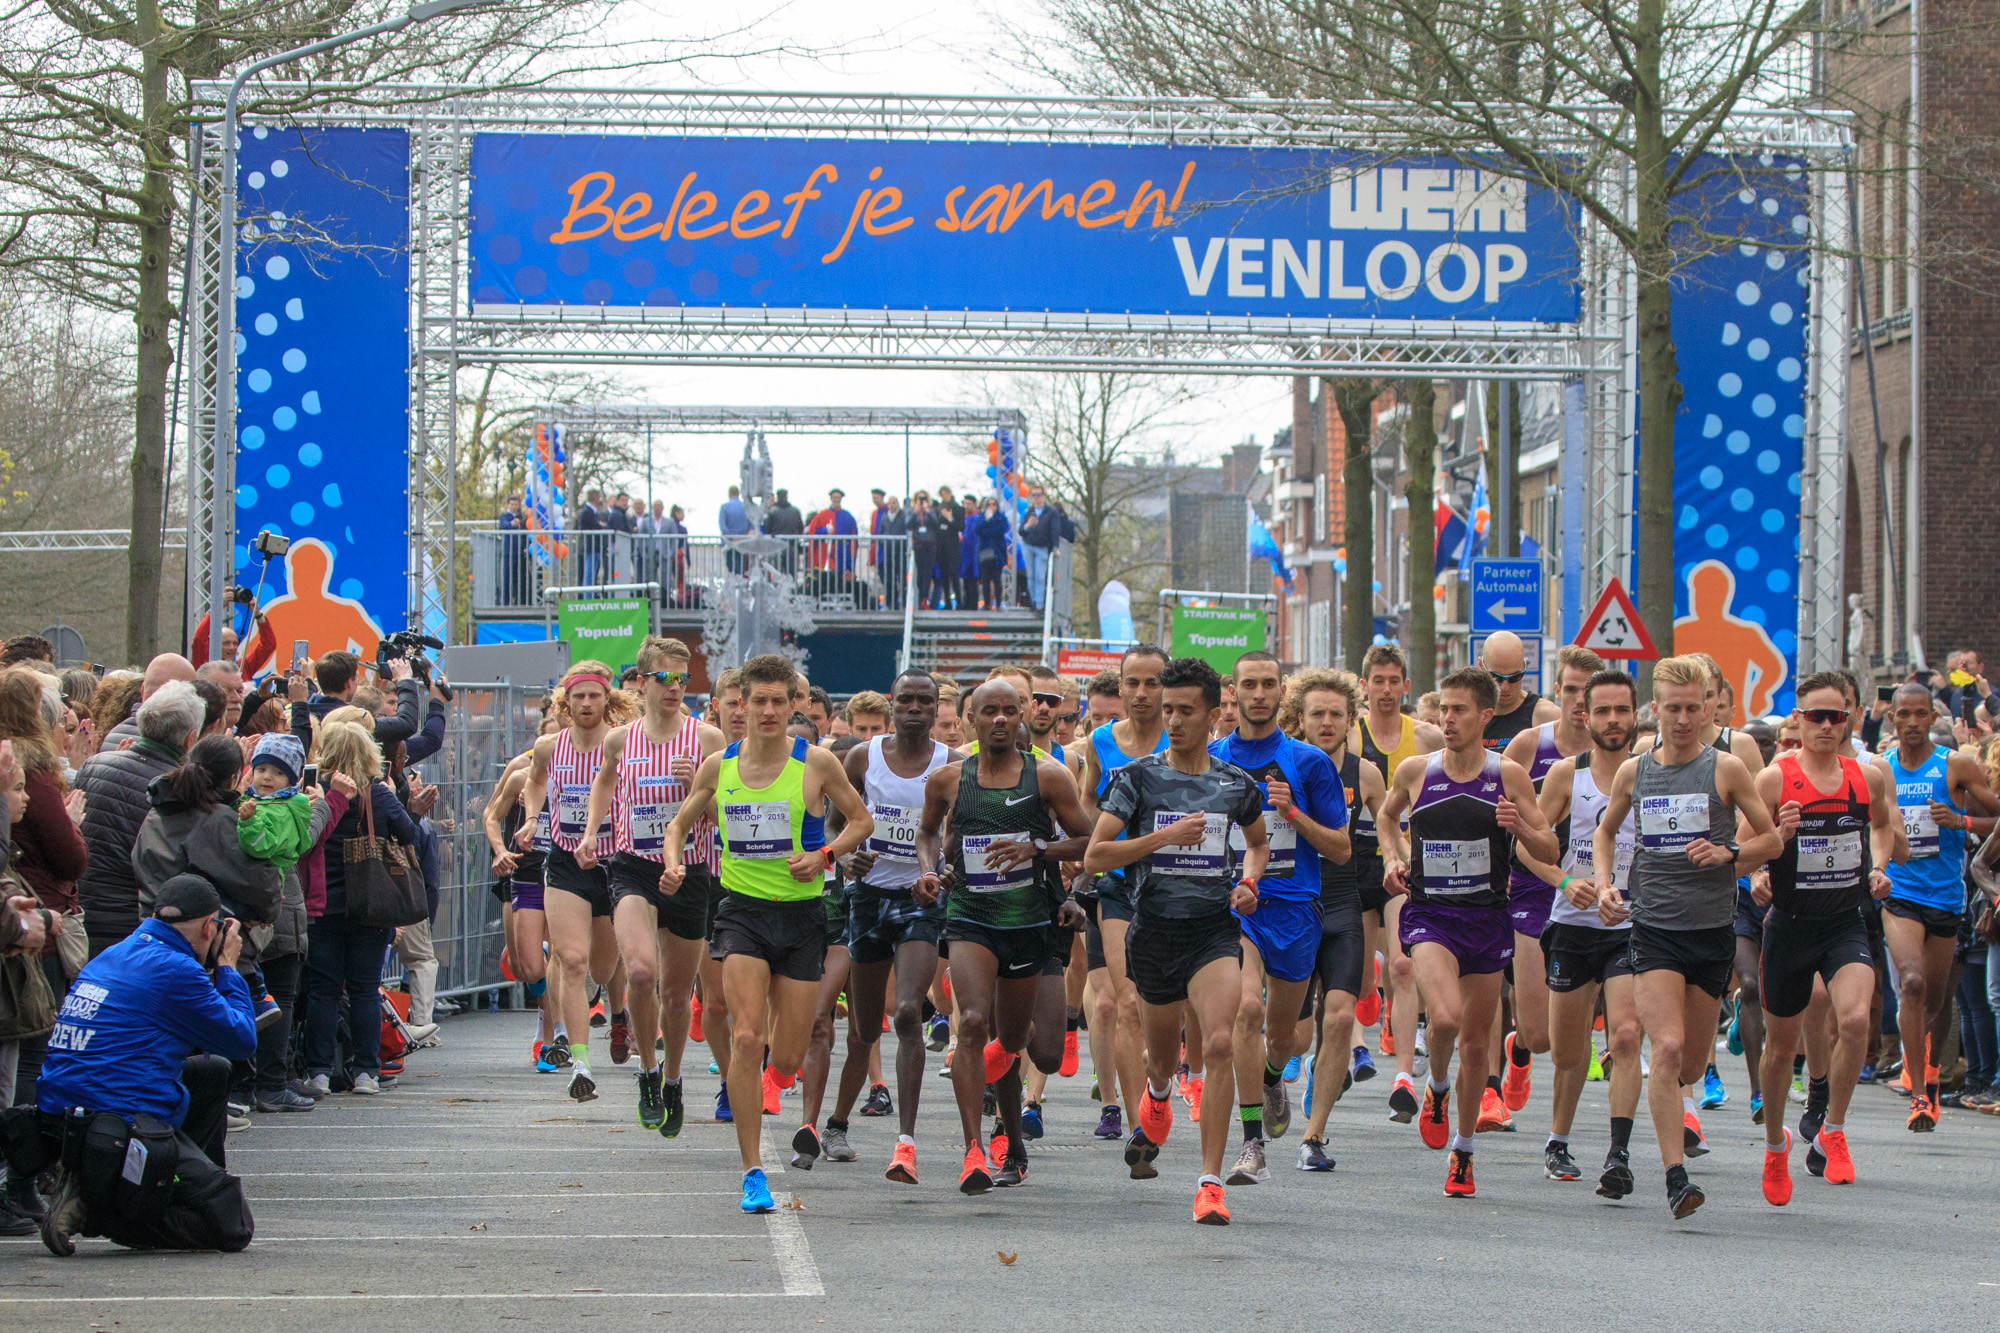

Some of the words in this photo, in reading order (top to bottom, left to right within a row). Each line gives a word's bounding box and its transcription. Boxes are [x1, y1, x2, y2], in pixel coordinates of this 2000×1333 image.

[550, 163, 838, 243] Beleef
[822, 166, 914, 263] je
[936, 161, 1196, 232] samen!
[1172, 236, 1528, 303] VENLOOP
[1483, 566, 1532, 578] Parkeer
[1476, 582, 1538, 593] Automaat
[567, 602, 620, 612] STARTVAK
[623, 602, 640, 610] HM
[1183, 609, 1237, 620] STARTVAK
[575, 624, 633, 640] Topveld
[1189, 633, 1248, 648] Topveld
[1896, 781, 1933, 796] UNCZECH
[1643, 807, 1680, 816] VENLOOP
[1686, 805, 1704, 813] 2019
[633, 813, 667, 822] VENLOOP
[726, 814, 762, 822] VENLOOP
[768, 813, 786, 821] 2019
[874, 814, 910, 825] VENLOOP
[1273, 822, 1291, 830] 2019
[1668, 816, 1678, 831] 6
[750, 824, 760, 838] 7
[887, 825, 915, 842] 100
[1204, 826, 1222, 834] 2019
[1660, 836, 1696, 844] Futselaar
[745, 843, 774, 851] Schröer
[1801, 846, 1838, 855] VENLOOP
[1843, 843, 1858, 852] 2019
[1468, 850, 1485, 858] 2019
[1175, 857, 1209, 866] Labquira
[1451, 860, 1458, 874] 1
[1825, 855, 1834, 869] 8
[996, 874, 1006, 882] Ali
[1834, 871, 1856, 879] Wielen
[47, 1022, 97, 1051] REW
